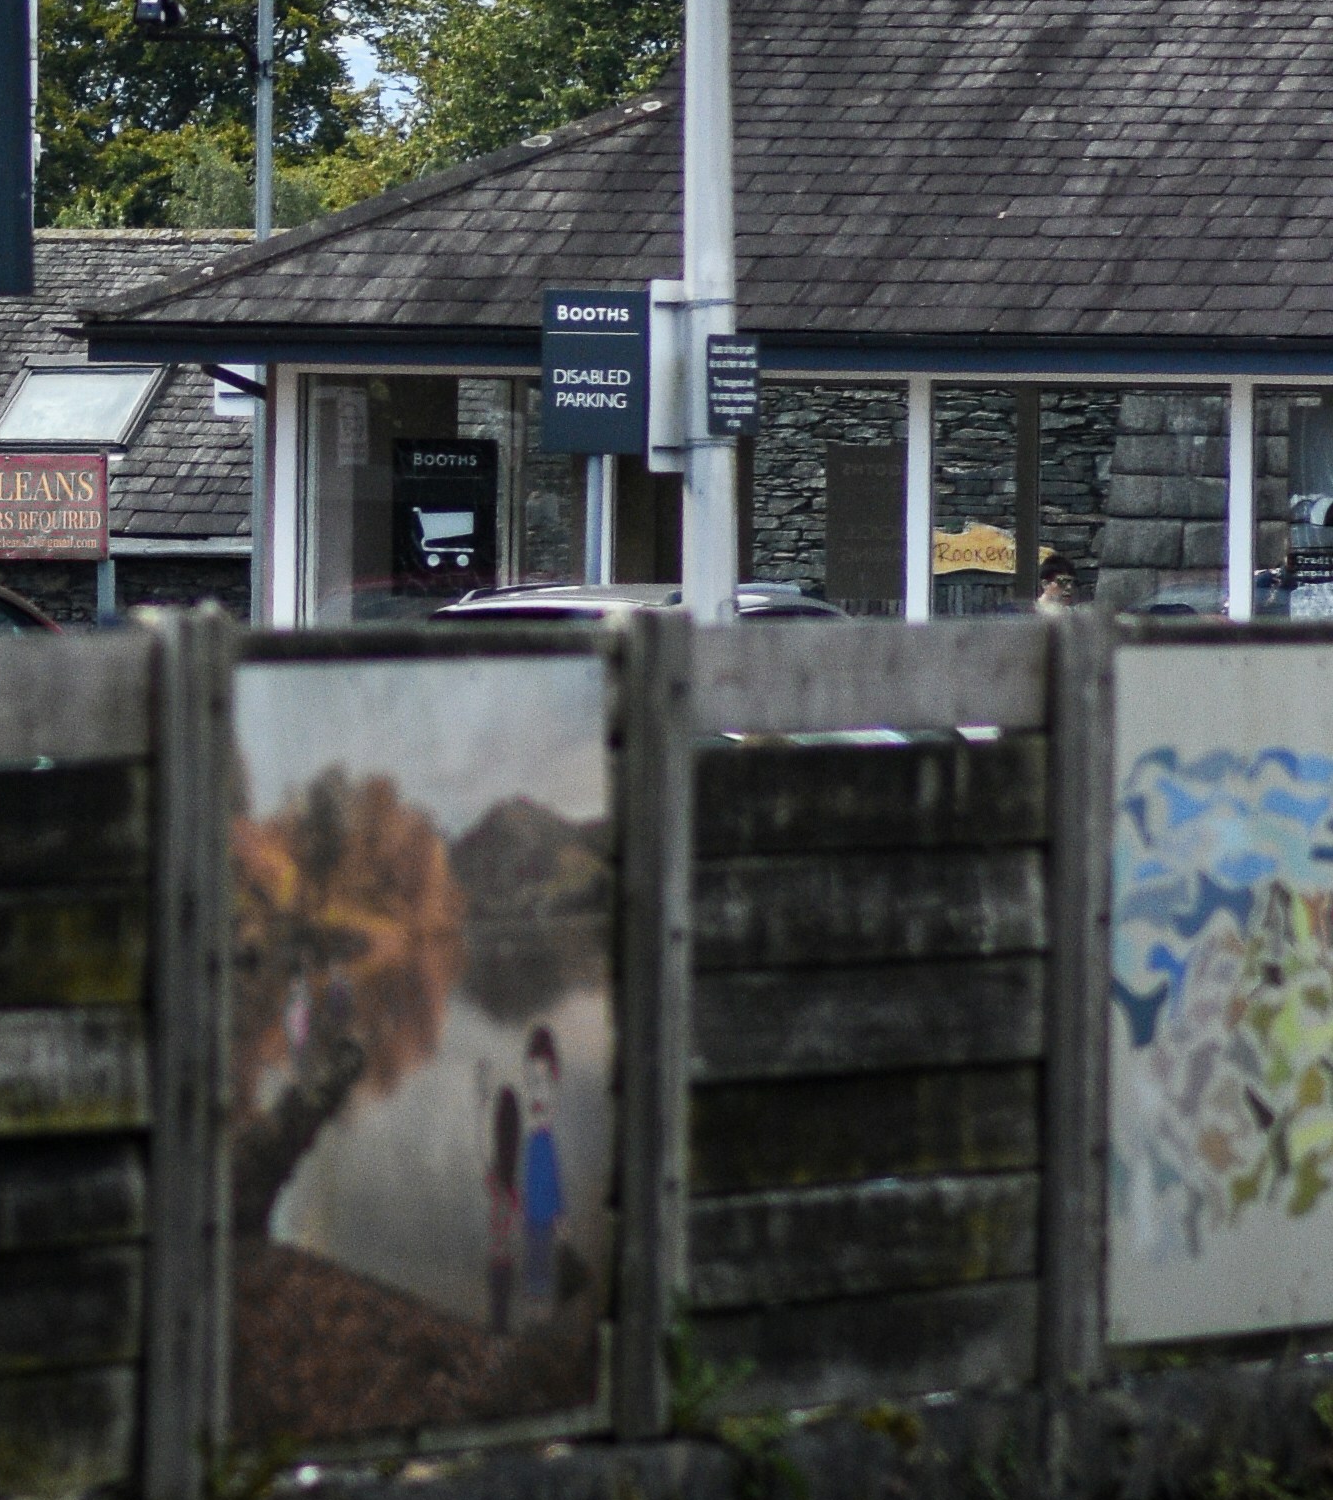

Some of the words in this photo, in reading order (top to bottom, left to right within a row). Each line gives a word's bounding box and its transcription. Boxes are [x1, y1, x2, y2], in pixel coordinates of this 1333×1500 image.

[556, 305, 630, 321] BOOTHS
[553, 369, 630, 385] DISABLED
[556, 392, 628, 409] PARKING
[413, 453, 478, 466] BOOTHS
[18, 510, 101, 533] REQUIRED
